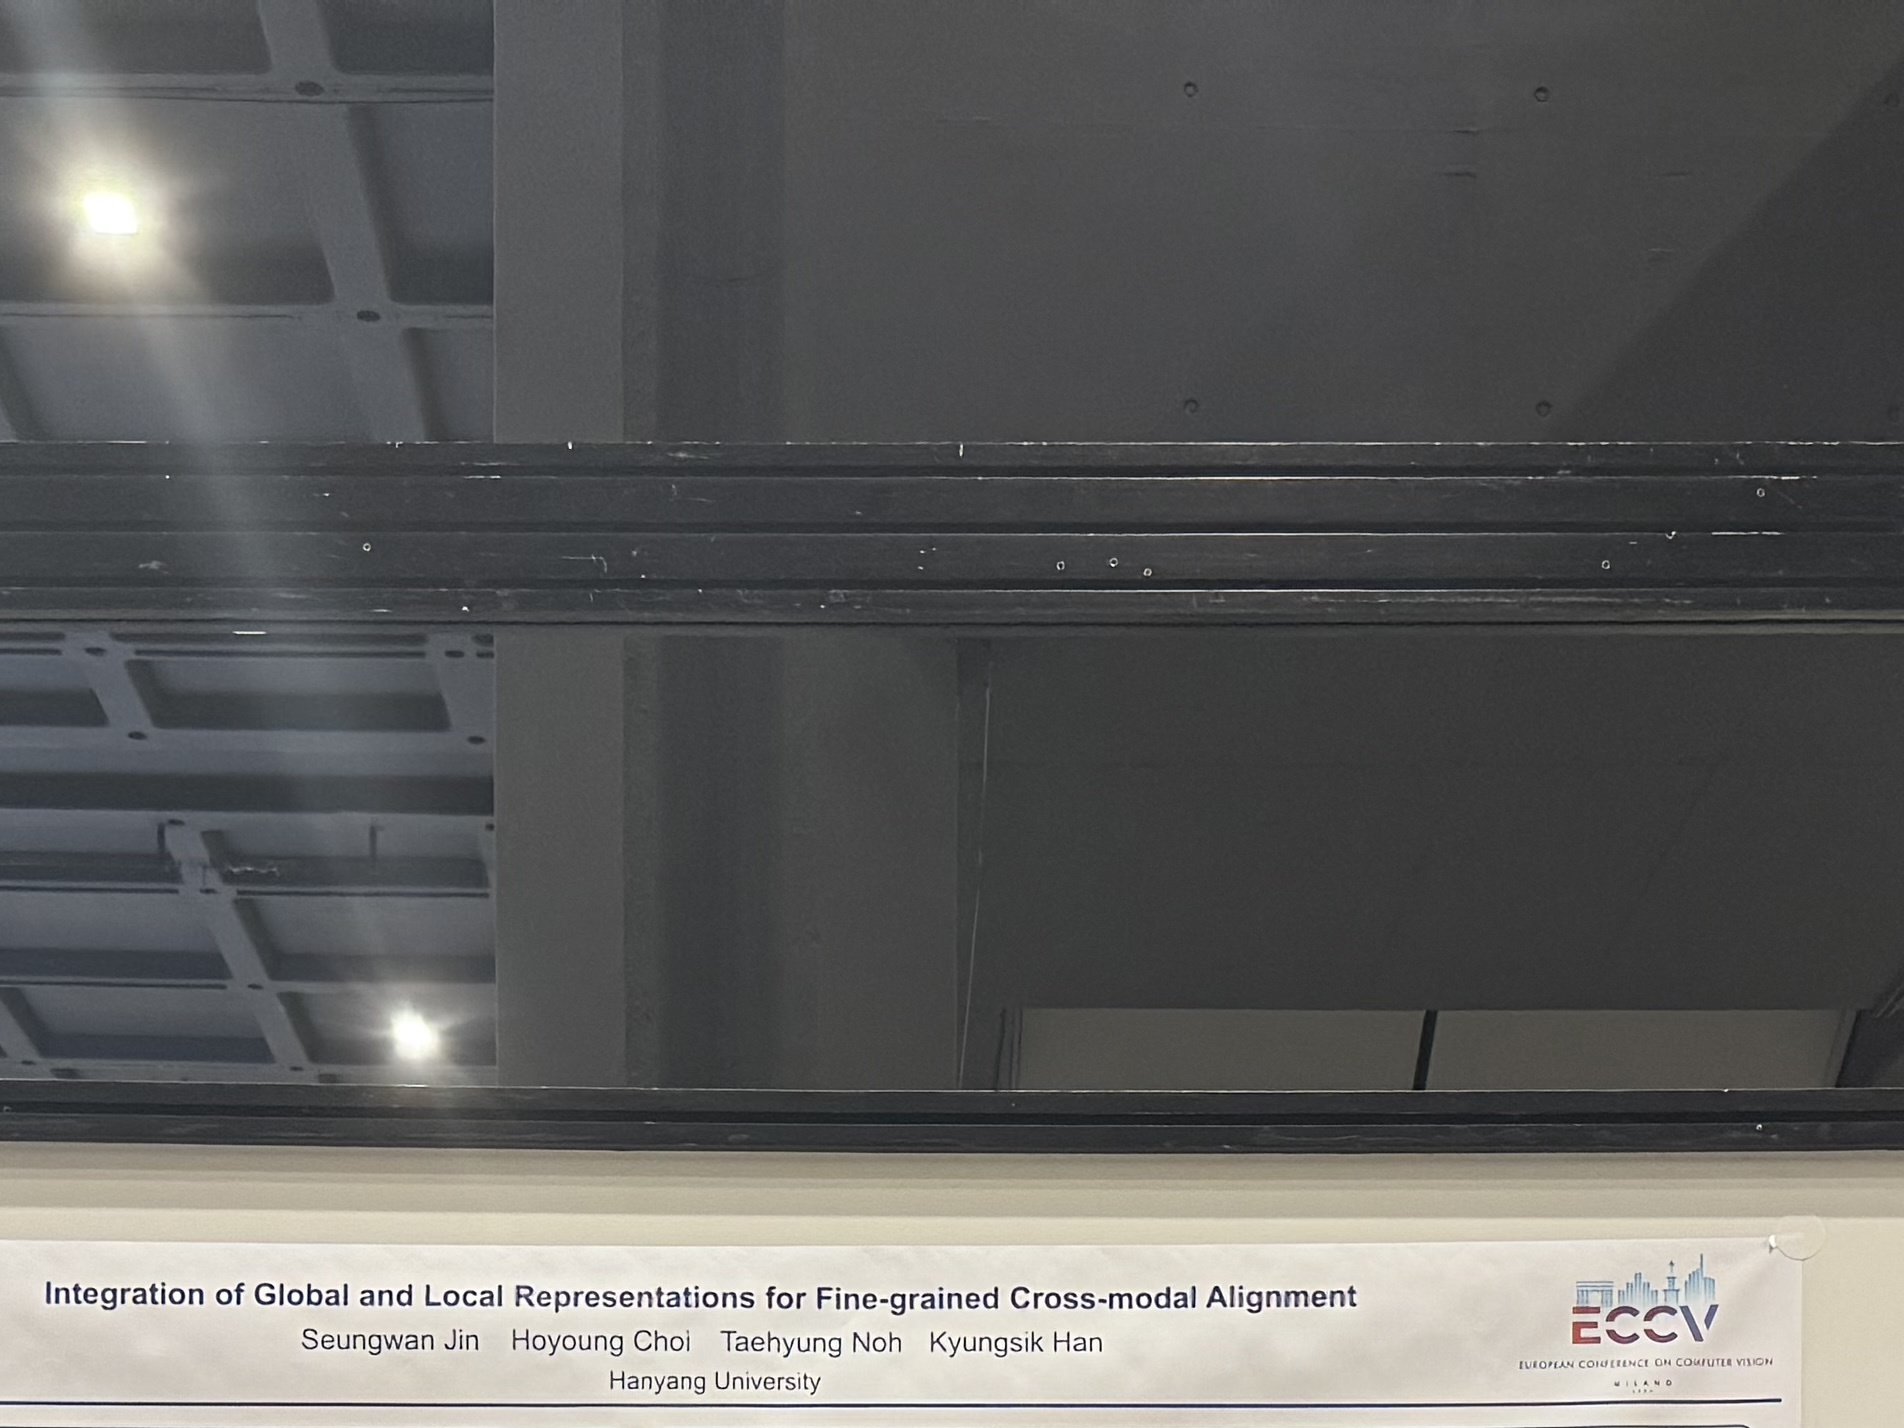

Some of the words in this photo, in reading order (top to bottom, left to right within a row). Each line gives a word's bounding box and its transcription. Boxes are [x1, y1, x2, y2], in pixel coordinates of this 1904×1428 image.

[46, 1281, 204, 1311] Integration
[216, 1282, 245, 1305] of
[254, 1283, 348, 1306] Global
[360, 1284, 413, 1307] and
[425, 1284, 503, 1307] Local
[515, 1285, 755, 1313] Representations
[765, 1286, 807, 1309] for
[817, 1286, 999, 1316] Fine-grained
[1011, 1285, 1196, 1310] Cross-modal
[1206, 1285, 1357, 1314] Alignment
[1571, 1304, 1719, 1345] ECCV
[301, 1328, 434, 1356] Seungwan
[444, 1329, 479, 1351] Jin
[512, 1328, 623, 1357] Hoyoung
[634, 1330, 690, 1352] Choi
[720, 1330, 842, 1358] Taehyung
[853, 1331, 901, 1353] Noh
[931, 1331, 1044, 1358] Kyungsik
[1054, 1331, 1102, 1352] Han
[610, 1370, 706, 1395] Hanyang
[715, 1371, 821, 1396] University
